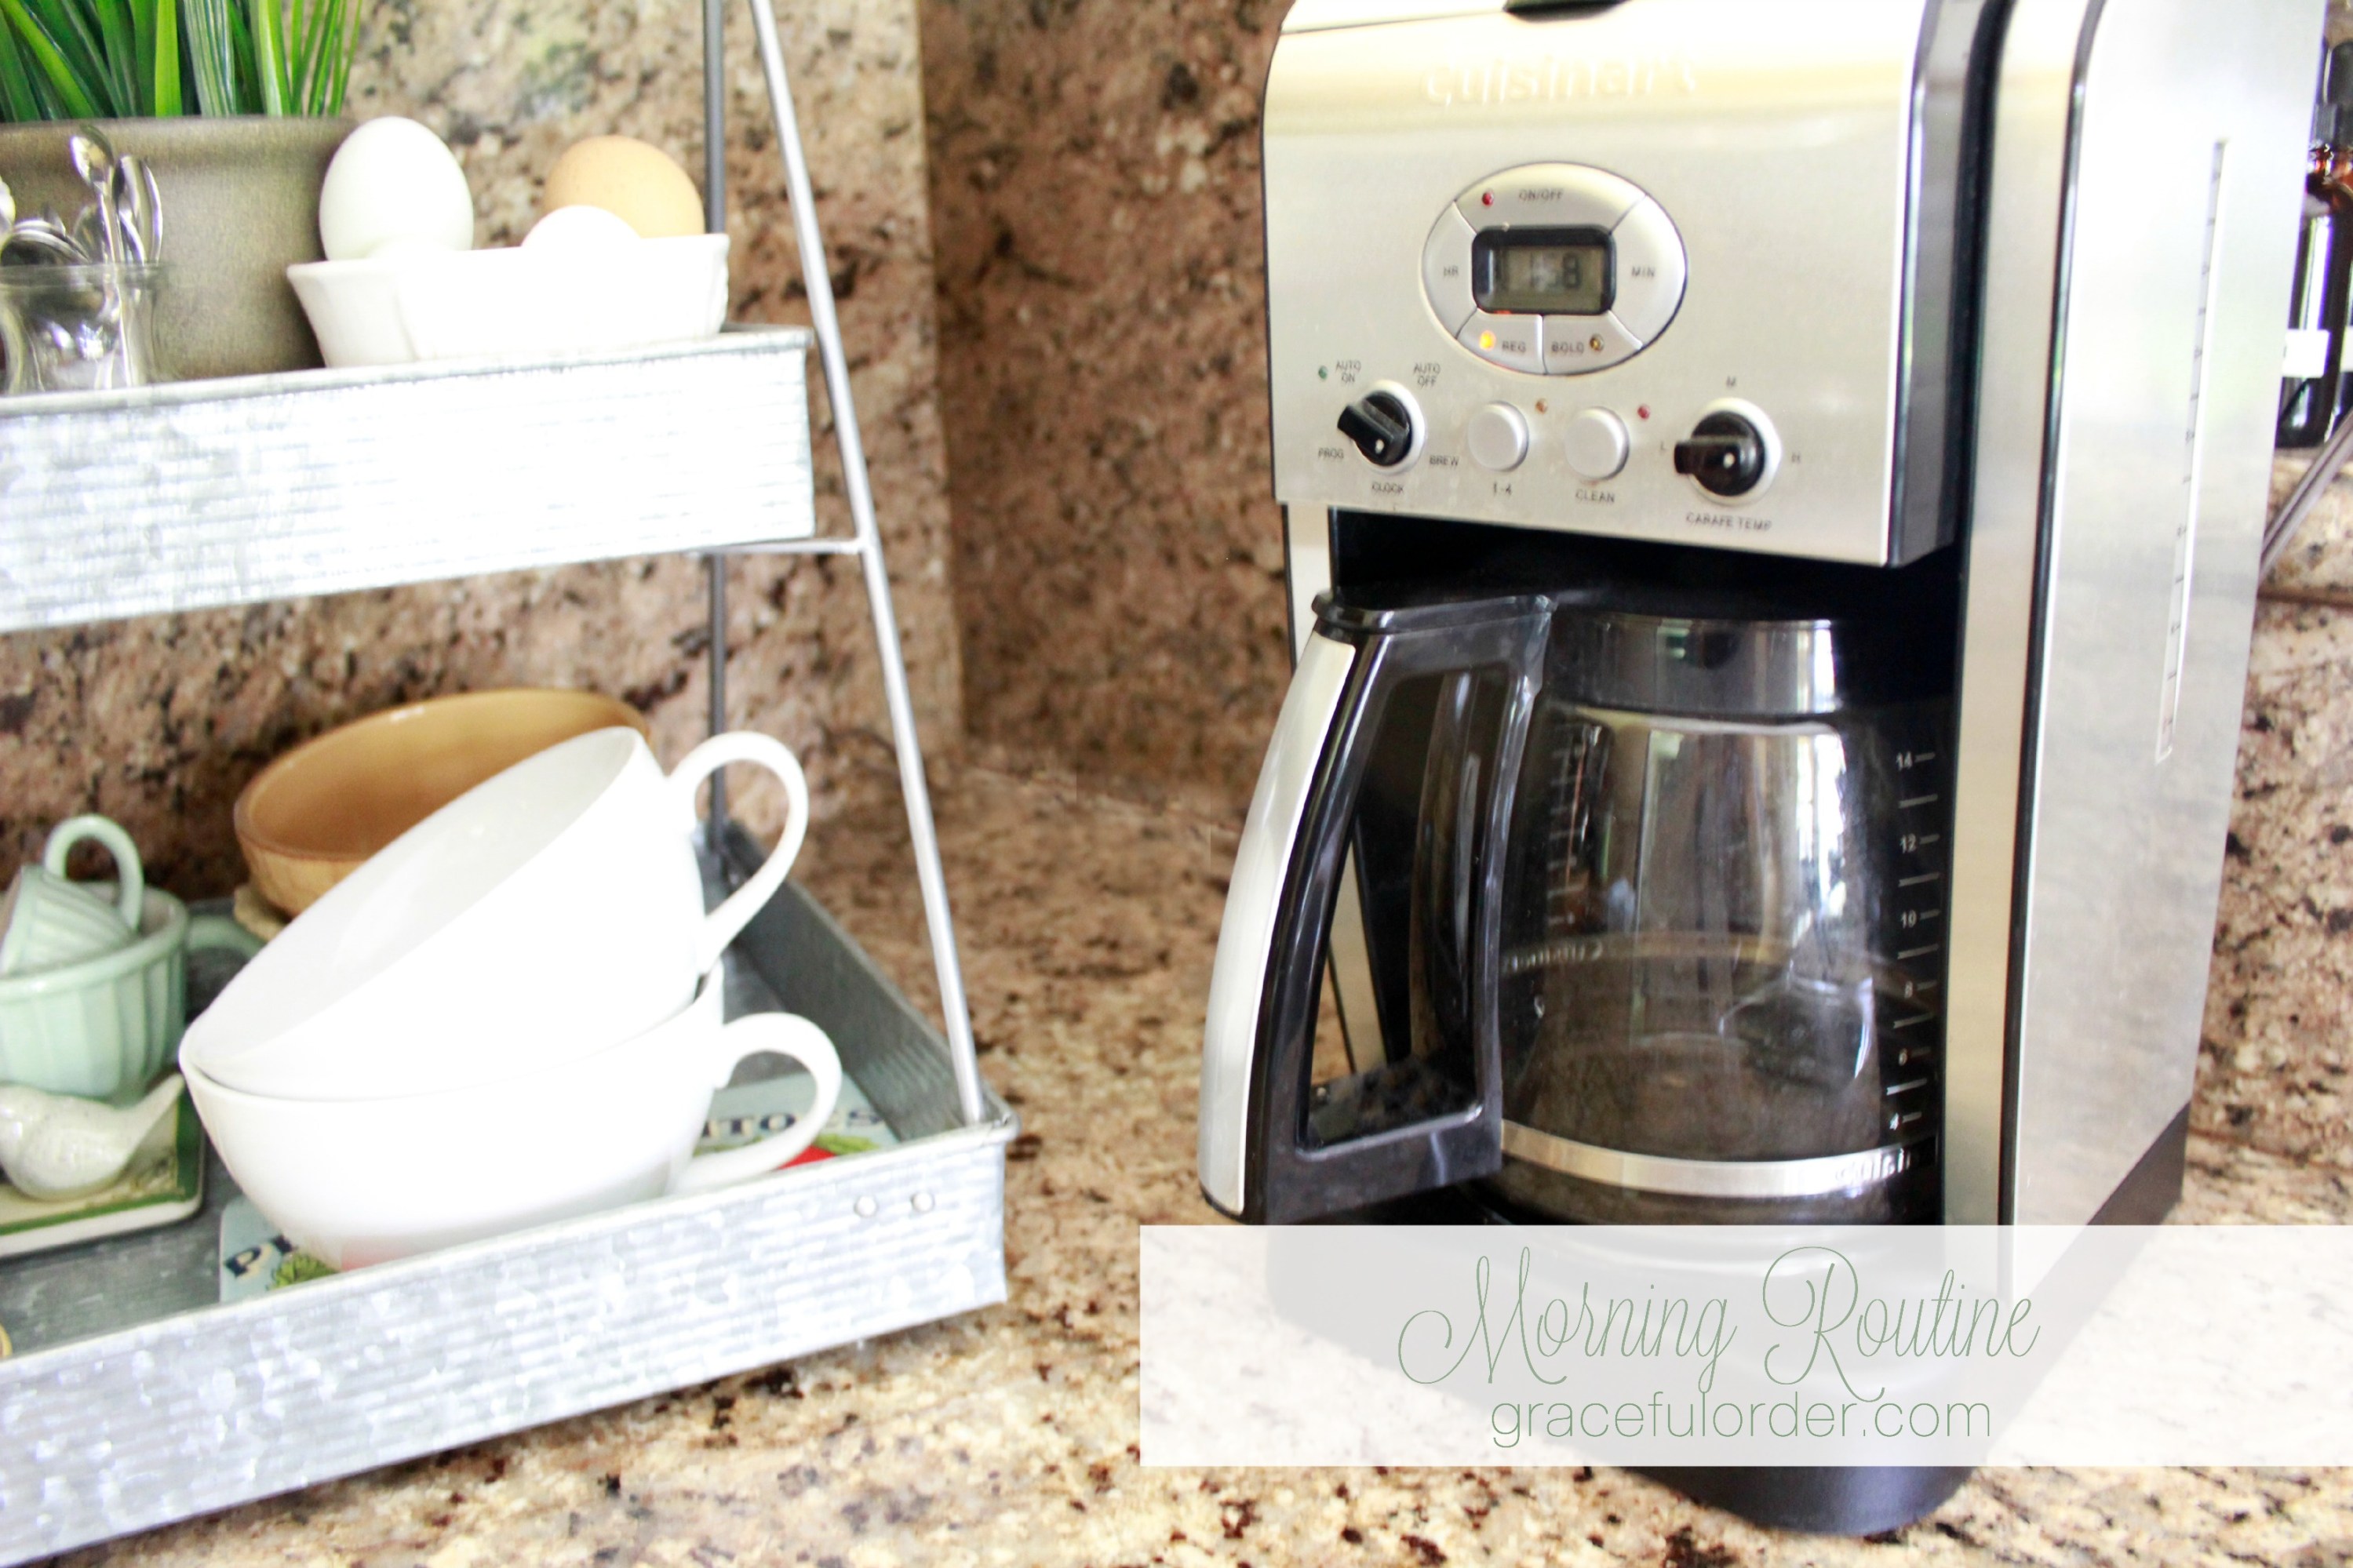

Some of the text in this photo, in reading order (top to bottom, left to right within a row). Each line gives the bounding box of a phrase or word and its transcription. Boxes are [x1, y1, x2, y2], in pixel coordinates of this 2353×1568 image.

[1518, 188, 1564, 201] ON/OFF
[1442, 266, 1459, 277] HR
[1630, 266, 1655, 278] MIN
[1502, 340, 1526, 353] REG
[1550, 340, 1585, 354] BOLD
[1335, 361, 1361, 372] AUTO
[1413, 362, 1441, 375] AUTO
[1342, 373, 1356, 384] ON
[1417, 376, 1437, 387] OFF
[1726, 376, 1736, 387] M
[1317, 448, 1345, 459] PROG
[1429, 455, 1459, 467] BREW
[1371, 482, 1404, 493] CLOCK
[1575, 489, 1615, 504] CLEAN
[1686, 512, 1772, 529] CARAFE TEMP
[1896, 751, 1913, 771] 14
[1900, 833, 1918, 853] 12
[1901, 909, 1917, 929] 10
